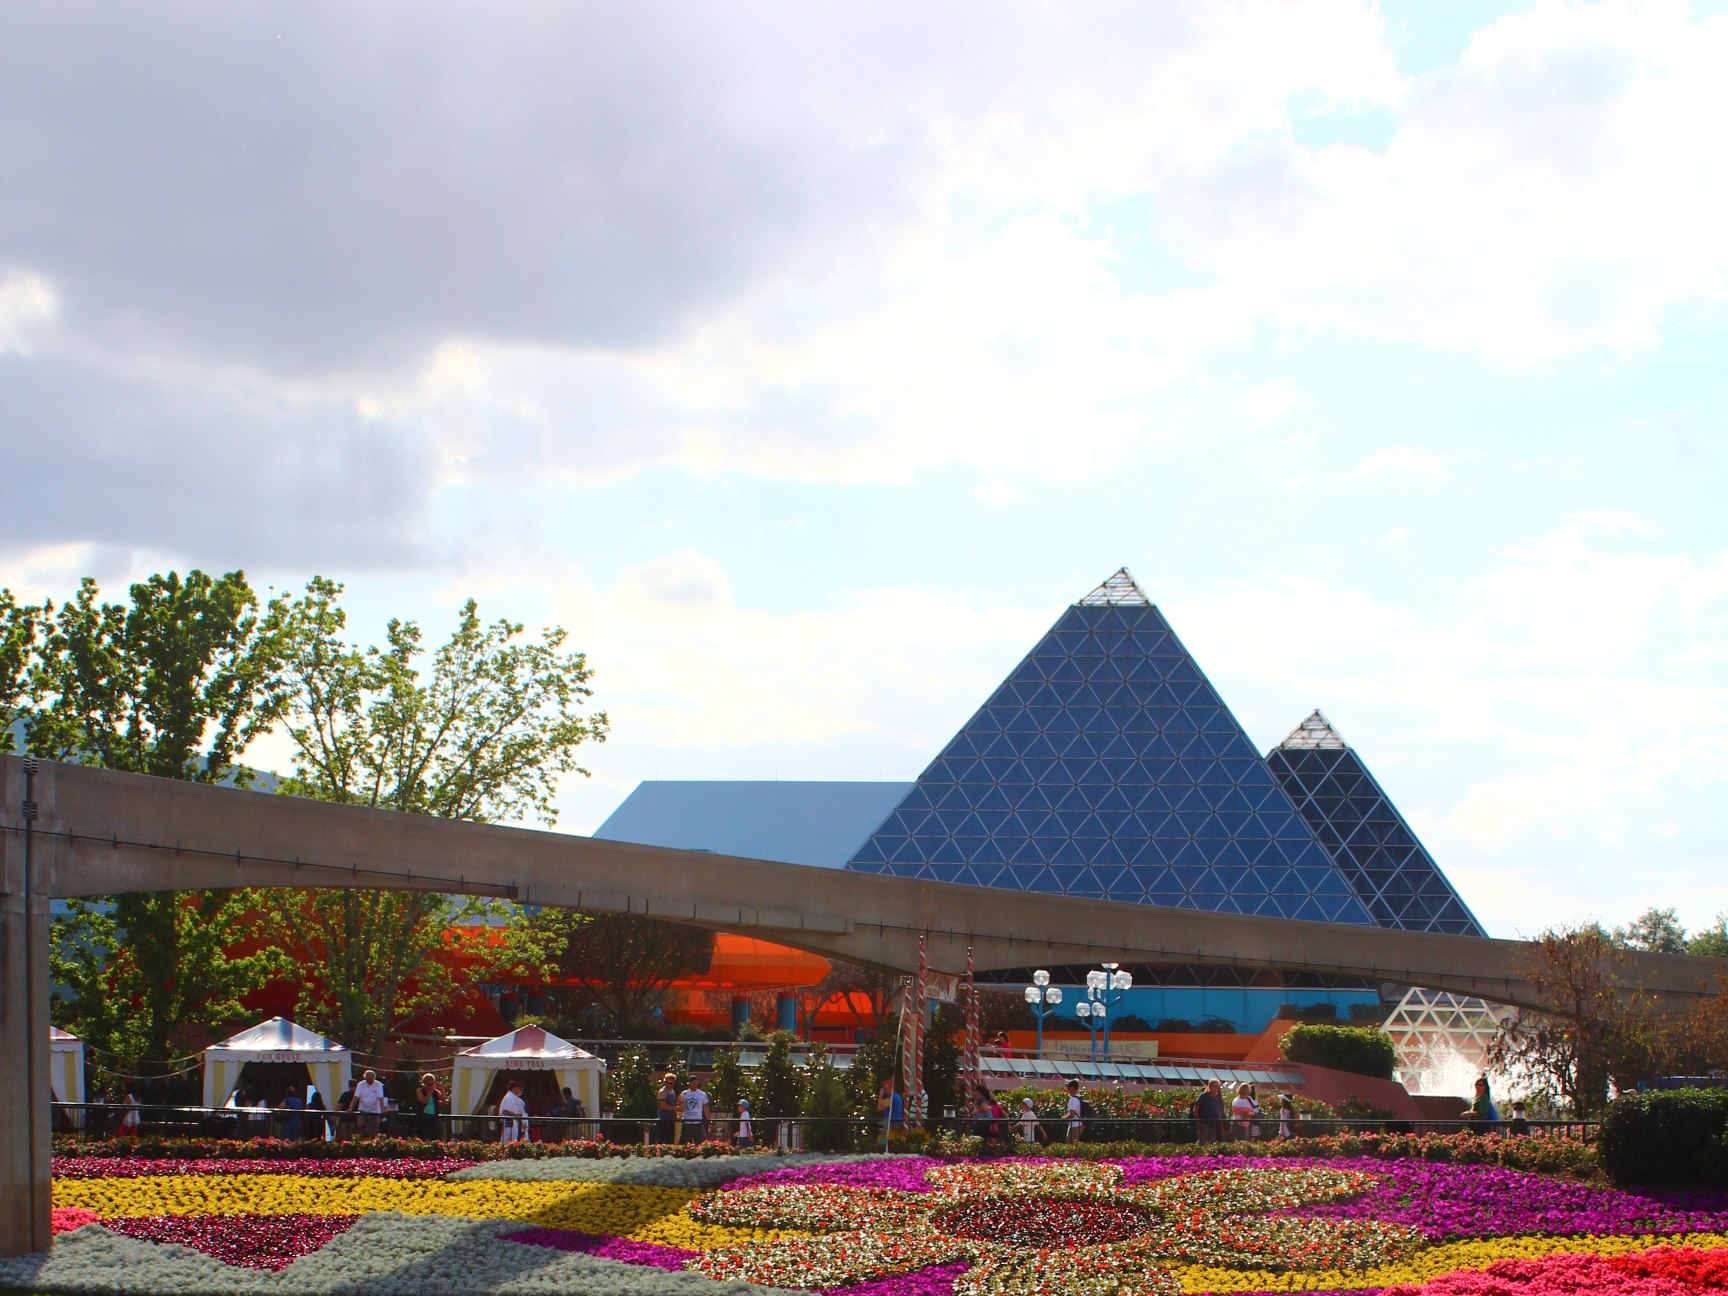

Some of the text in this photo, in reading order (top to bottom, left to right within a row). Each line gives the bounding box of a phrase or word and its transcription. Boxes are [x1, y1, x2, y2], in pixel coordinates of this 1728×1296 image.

[256, 1052, 301, 1061] FUN HOUSE
[505, 1060, 544, 1068] RING TOSS
